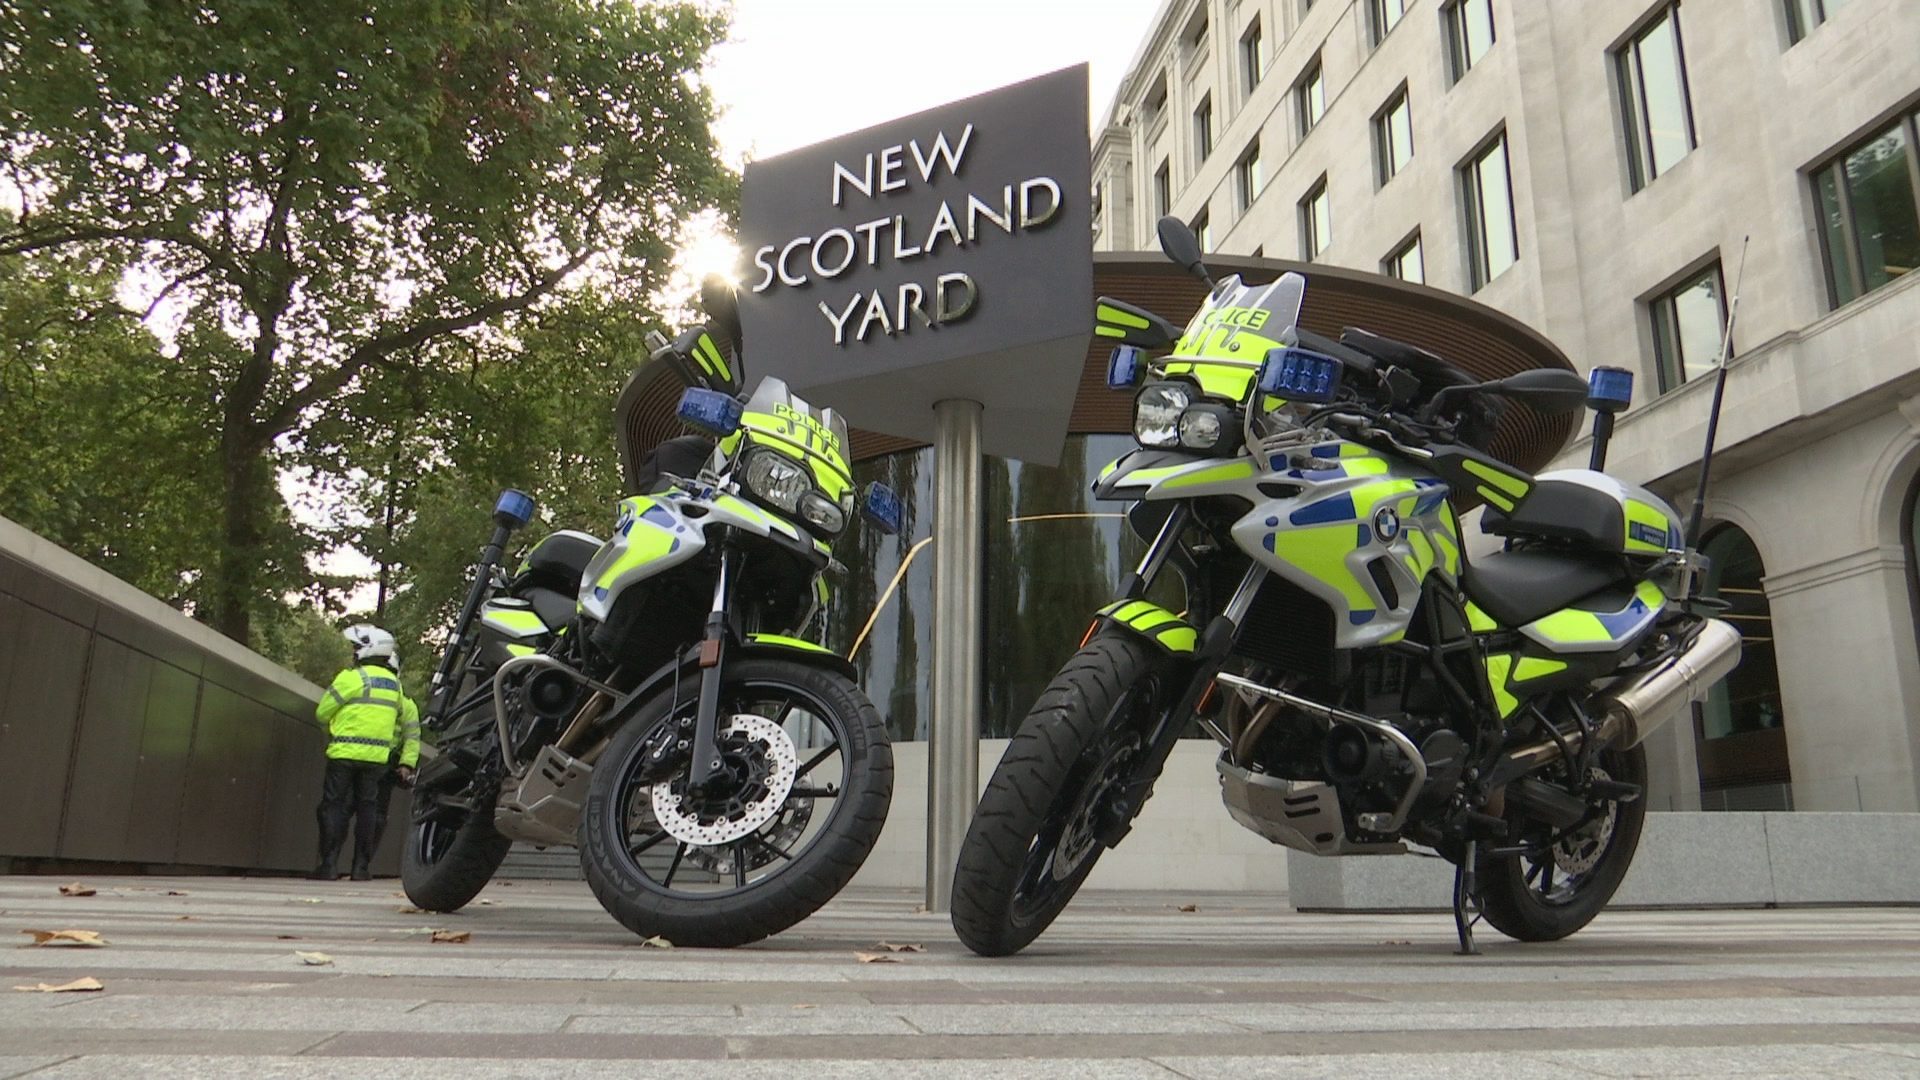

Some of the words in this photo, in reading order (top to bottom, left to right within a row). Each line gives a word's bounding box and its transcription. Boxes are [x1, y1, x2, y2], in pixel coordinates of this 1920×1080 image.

[832, 122, 974, 207] NEW
[752, 176, 1062, 294] SCOTLAND
[818, 272, 979, 346] YARD
[1202, 307, 1268, 329] OICE
[775, 403, 839, 453] POLICE
